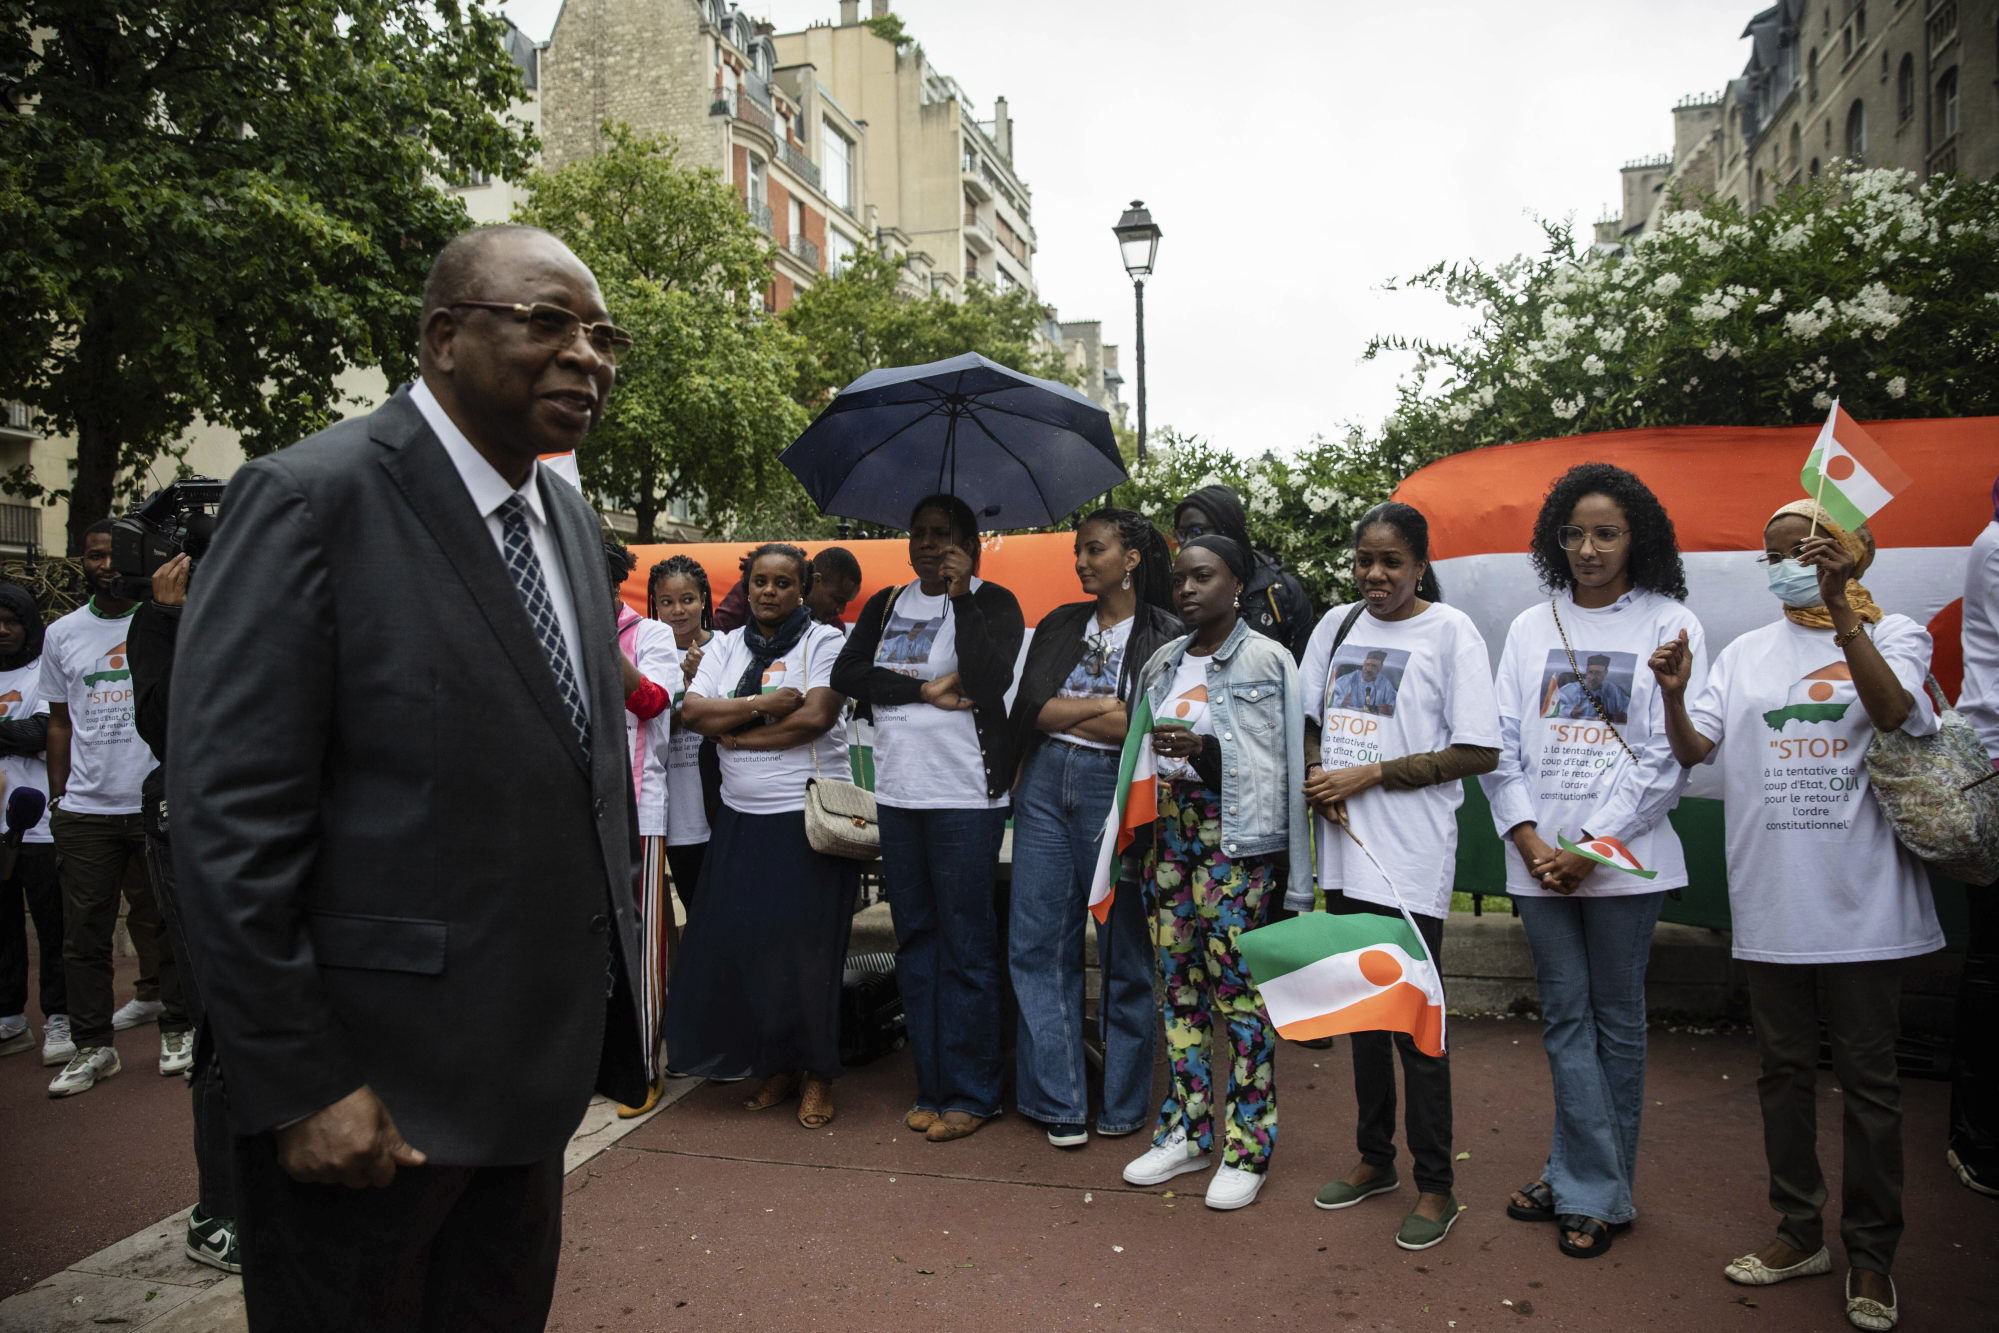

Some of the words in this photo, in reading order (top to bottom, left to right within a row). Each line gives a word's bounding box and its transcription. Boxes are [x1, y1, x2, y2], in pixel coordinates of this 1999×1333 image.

[1367, 741, 1378, 751] de
[1770, 738, 1848, 760] "STOP
[1357, 749, 1382, 764] OUI
[1552, 746, 1560, 754] la
[1562, 746, 1604, 757] tentative
[1331, 758, 1338, 766] le
[1542, 758, 1562, 767] coup
[1541, 770, 1559, 779] pour
[1562, 769, 1570, 777] le
[1764, 768, 1770, 778] à
[1774, 768, 1783, 777] la
[1786, 766, 1838, 776] tentative
[1841, 766, 1856, 776] de
[1561, 780, 1588, 789] l'ordre
[1764, 782, 1788, 792] coup
[1790, 780, 1827, 790] d'Etat,
[1830, 776, 1860, 791] OUI
[1764, 795, 1788, 806] pour
[1790, 794, 1800, 803] le
[1804, 795, 1841, 803] retour
[1843, 792, 1850, 802] à
[1792, 806, 1830, 816] l'ordre
